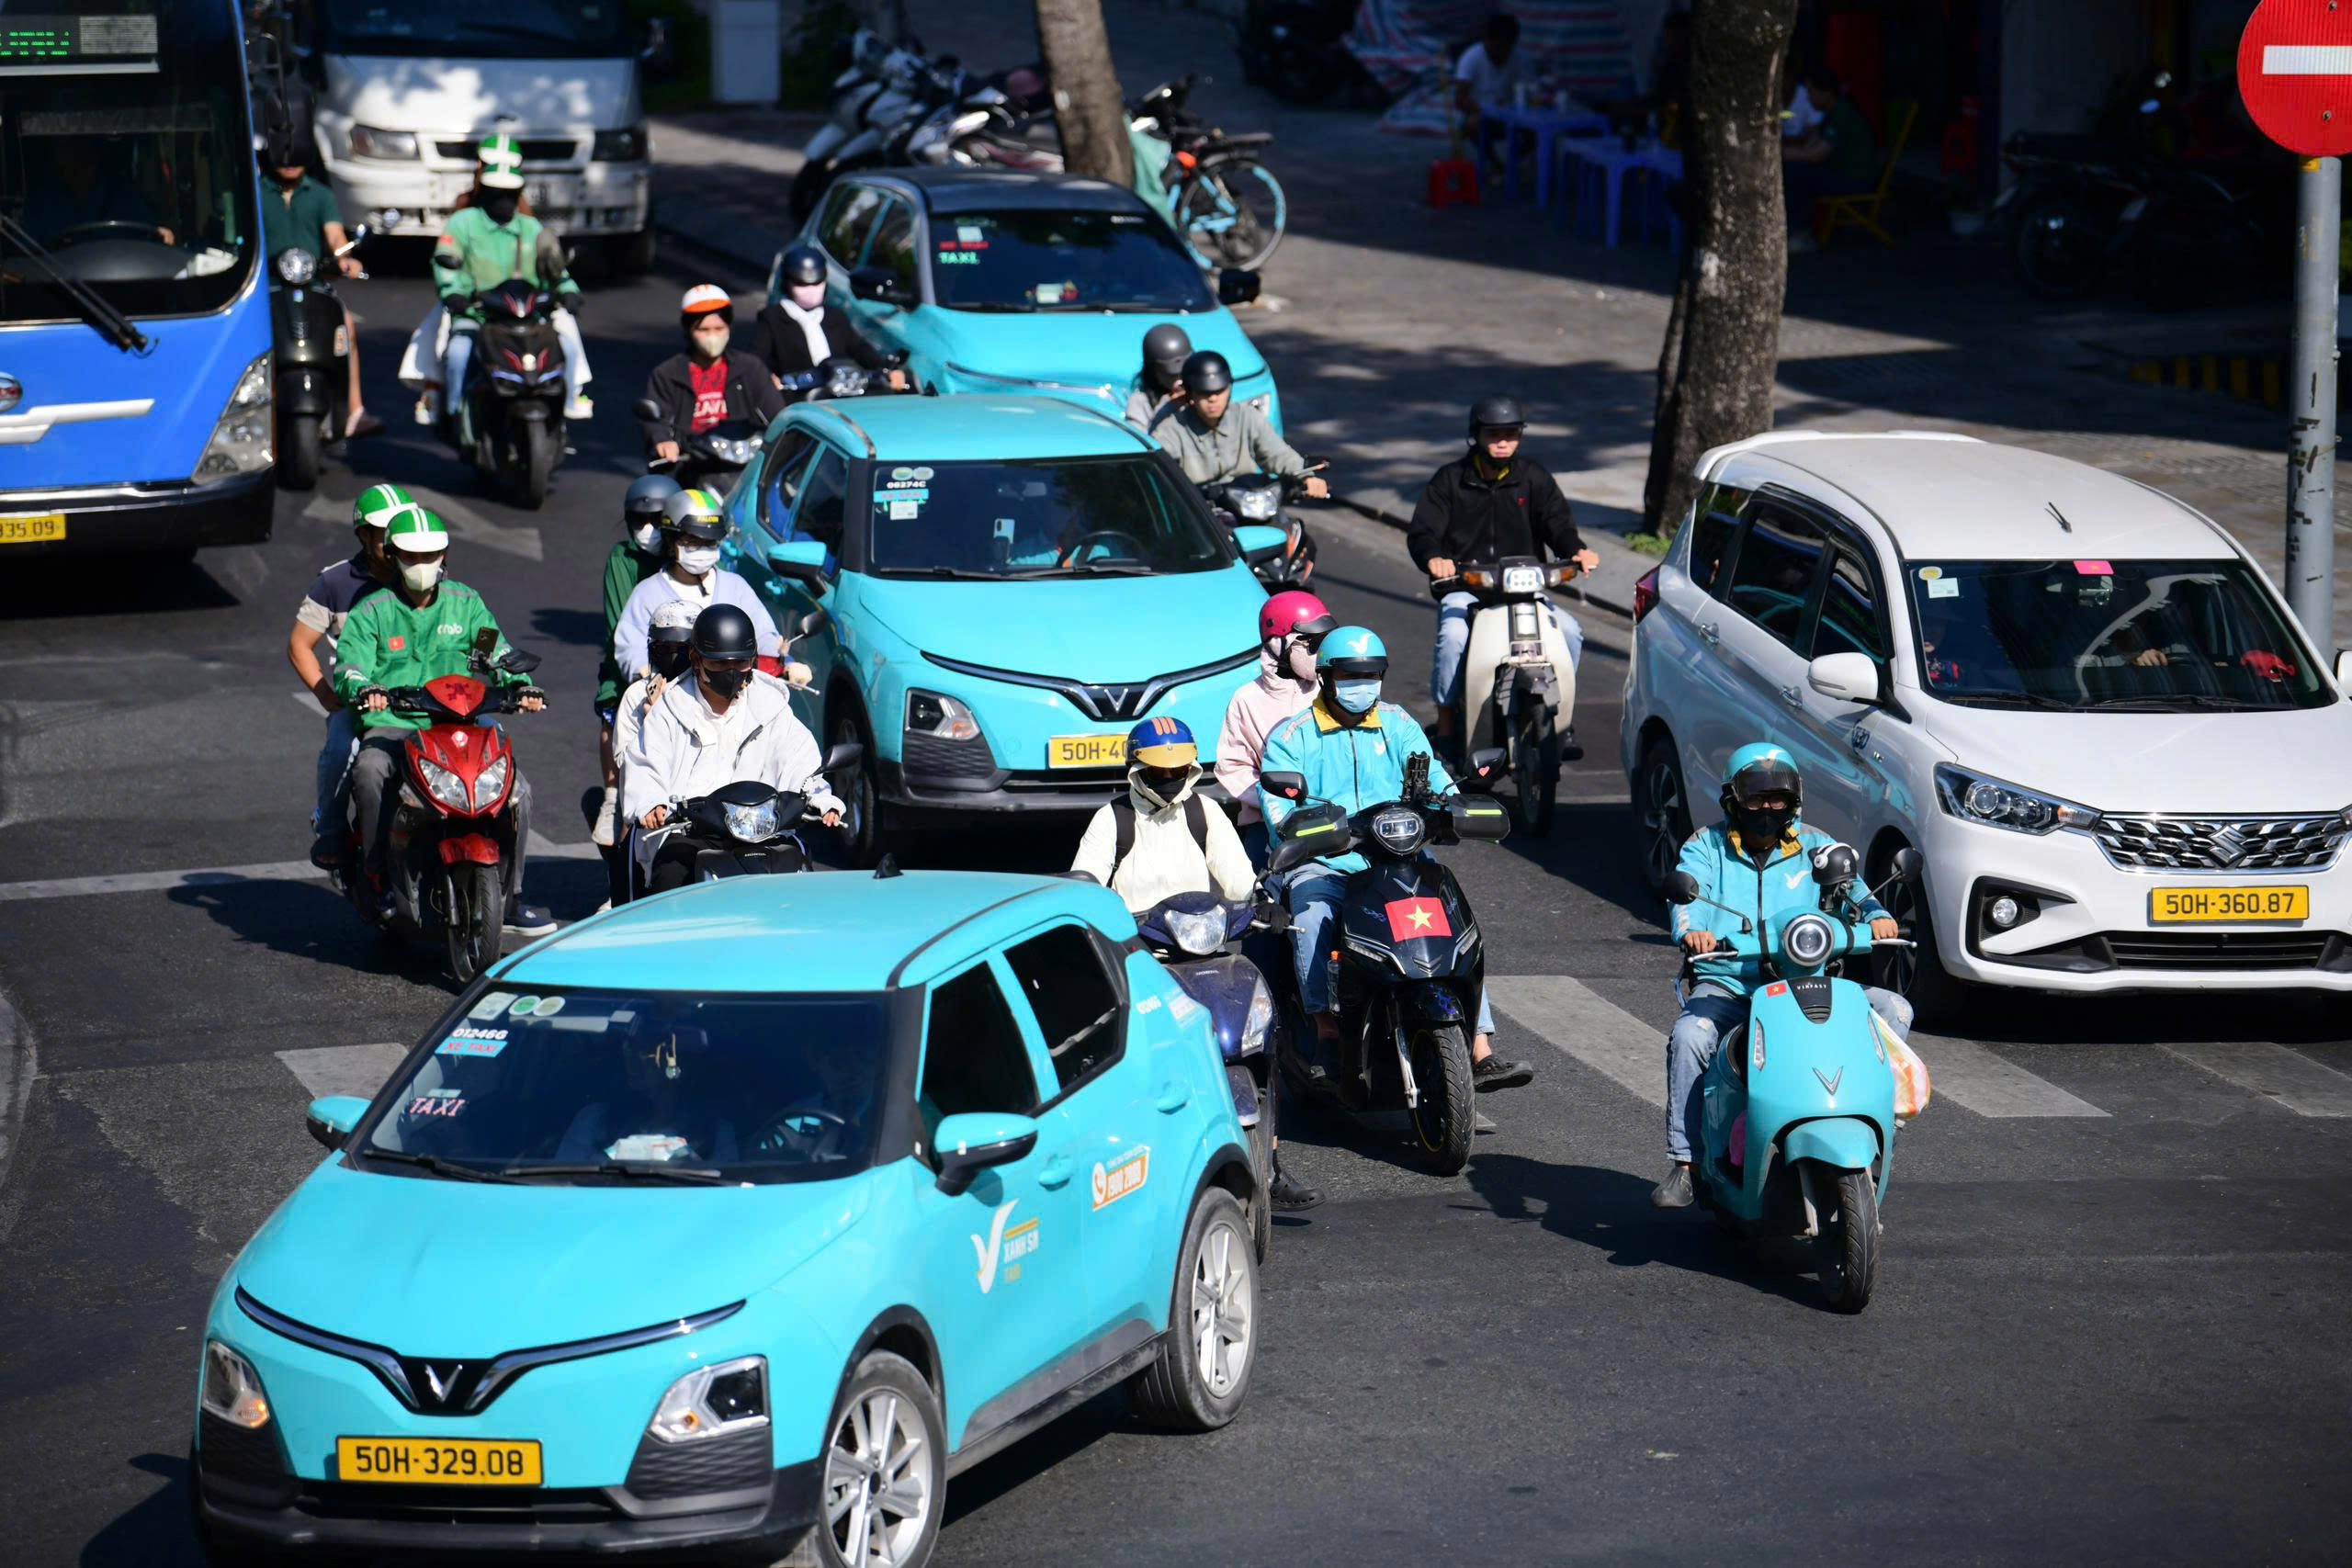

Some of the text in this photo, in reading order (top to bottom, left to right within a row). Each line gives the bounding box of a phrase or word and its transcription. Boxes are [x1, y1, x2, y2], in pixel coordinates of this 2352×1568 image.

[938, 252, 979, 265] TAXI
[2165, 892, 2295, 915] 50H-360.87
[409, 1097, 466, 1117] TAXI
[356, 1446, 524, 1476] 50H-329.08
